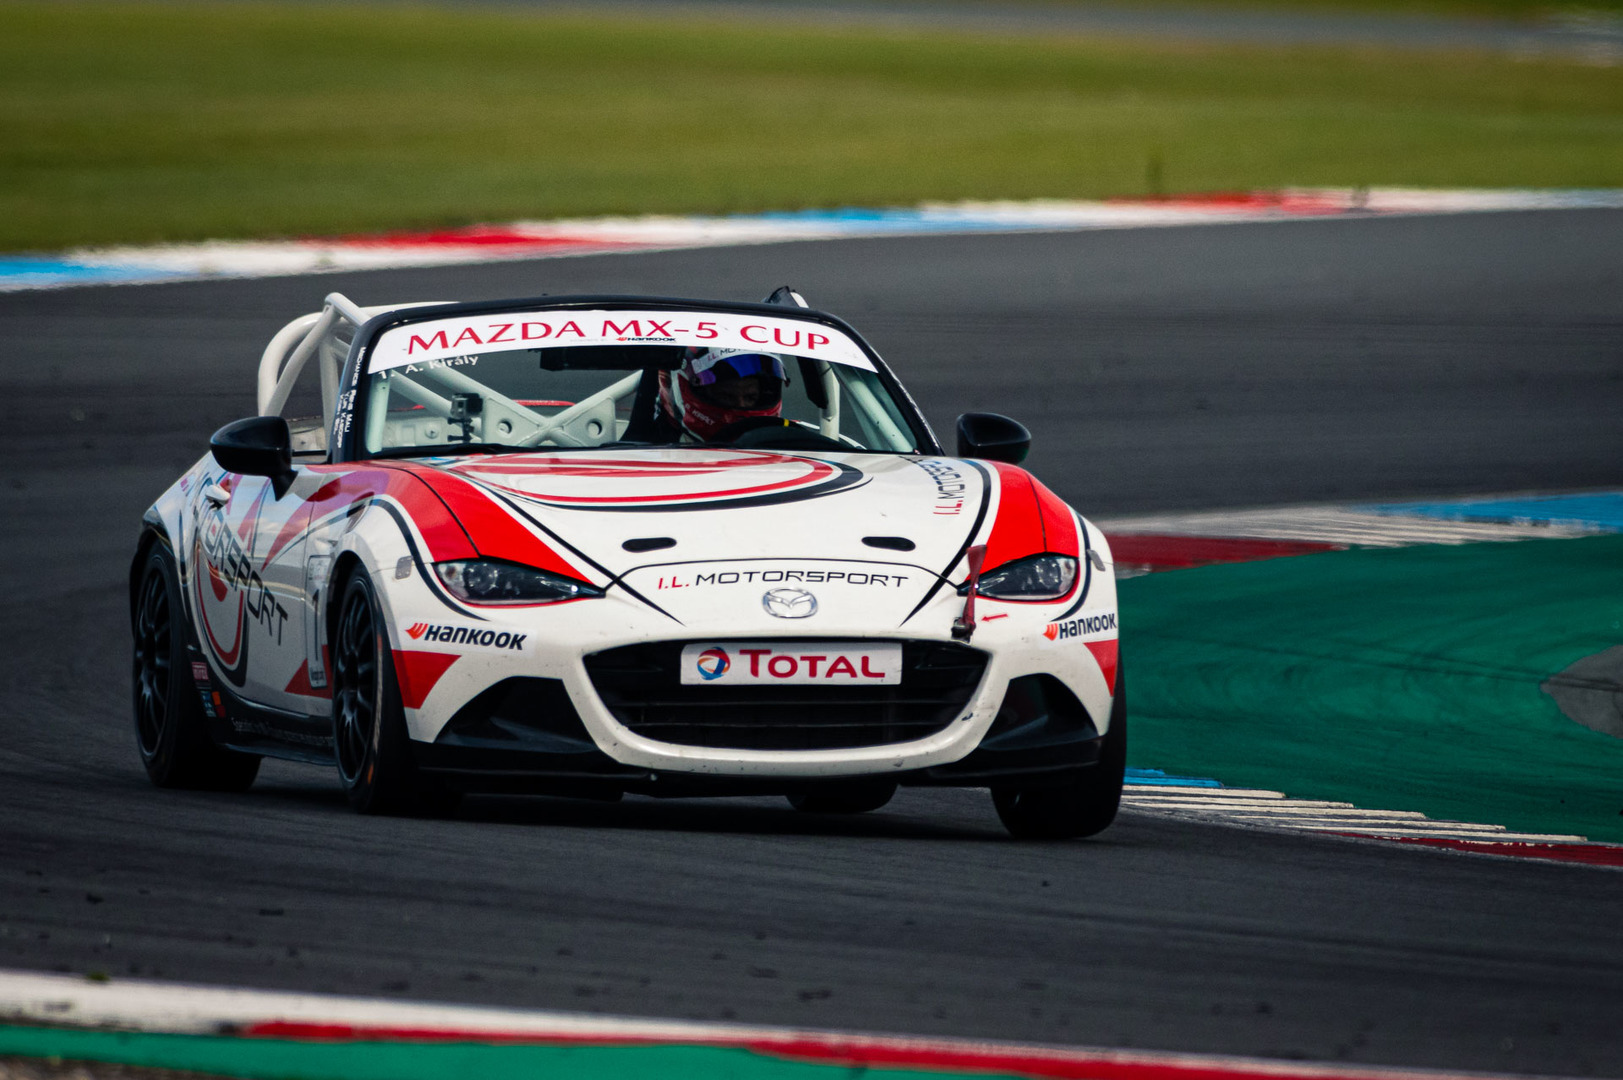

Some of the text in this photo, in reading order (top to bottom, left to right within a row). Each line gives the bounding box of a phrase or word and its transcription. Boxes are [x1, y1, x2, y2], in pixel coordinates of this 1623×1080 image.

[408, 319, 830, 355] MAZDA MX-5 CUP
[405, 364, 424, 374] A.
[658, 570, 909, 590] I.L. MOTORSPORT
[739, 649, 886, 679] TOTAL
